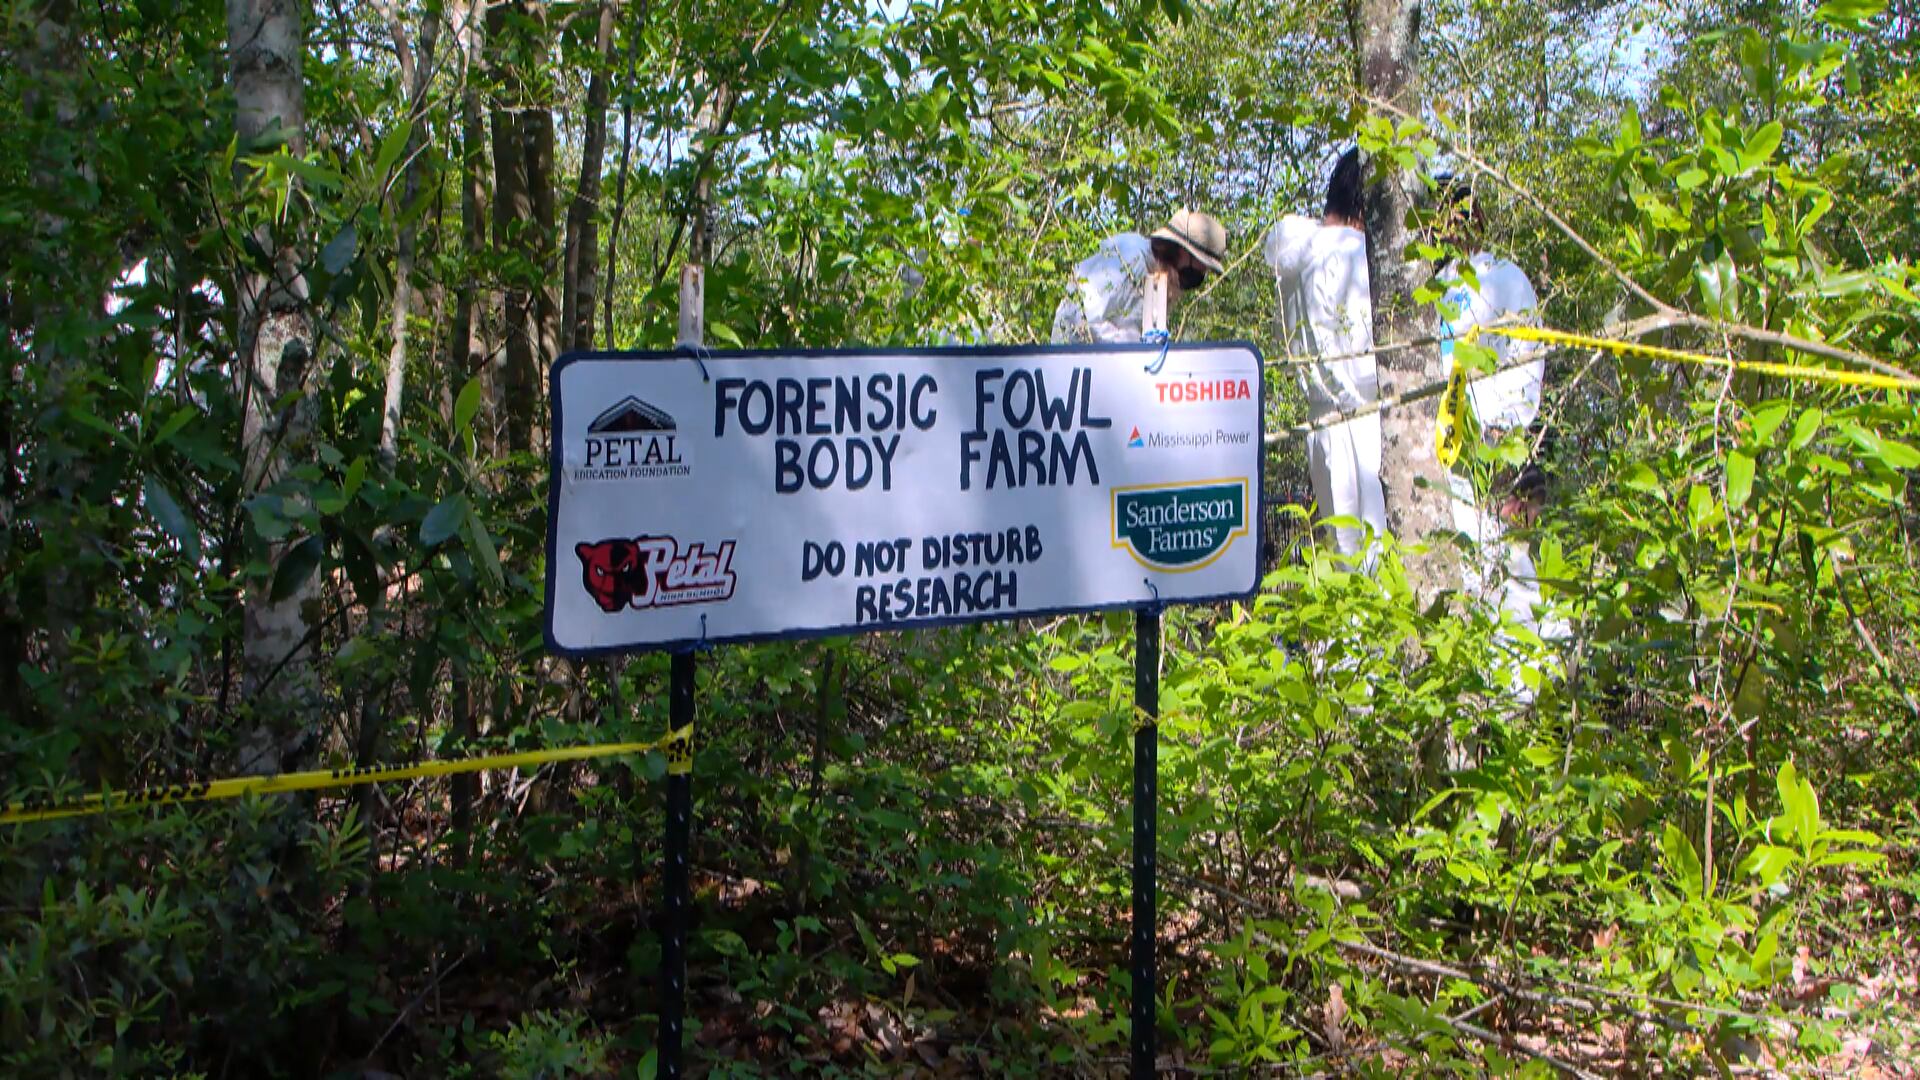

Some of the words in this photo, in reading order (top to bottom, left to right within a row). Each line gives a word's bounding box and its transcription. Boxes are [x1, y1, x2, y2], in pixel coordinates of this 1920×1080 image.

[714, 374, 938, 438] FORENSIC
[975, 367, 1112, 432] FOWL
[1156, 379, 1251, 403] TOSHIBA
[584, 435, 682, 467] PETAL
[1148, 430, 1213, 448] Mississippi
[1216, 429, 1251, 445] Power
[574, 468, 628, 481] EDUCATION
[630, 465, 691, 479] FOUNDATION
[775, 434, 900, 494] BODY
[960, 428, 1099, 491] FARM
[1126, 496, 1235, 529] Sanderson
[631, 535, 737, 608] Petal
[802, 539, 846, 581] DO
[854, 537, 912, 578] NOT
[922, 524, 1043, 570] DISTURB
[856, 570, 1018, 624] RESEARCH
